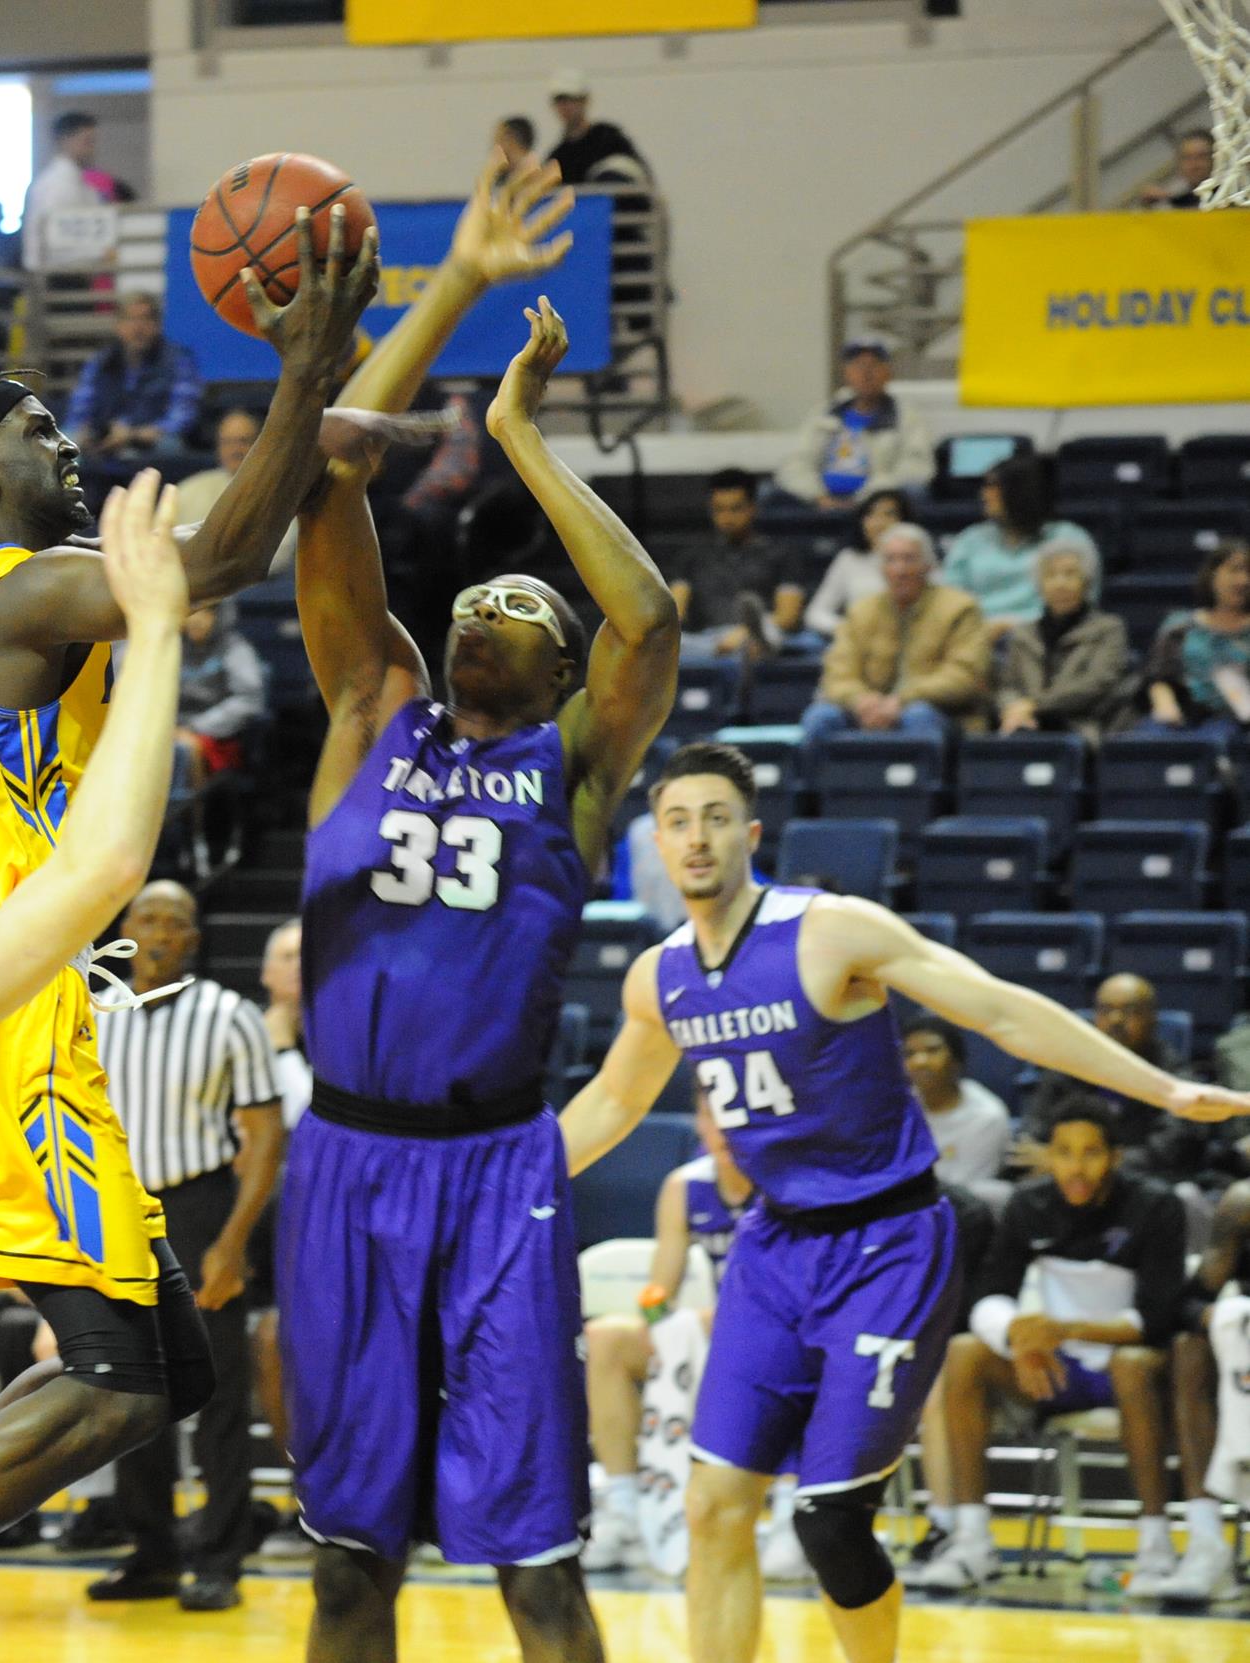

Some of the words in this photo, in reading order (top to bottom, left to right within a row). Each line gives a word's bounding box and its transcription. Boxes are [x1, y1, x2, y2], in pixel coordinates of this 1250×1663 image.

[1046, 287, 1197, 331] HOLIDAY
[369, 808, 503, 912] 33
[669, 1000, 798, 1049] TARLETON
[696, 1050, 796, 1130] 24
[854, 1333, 916, 1409] T
